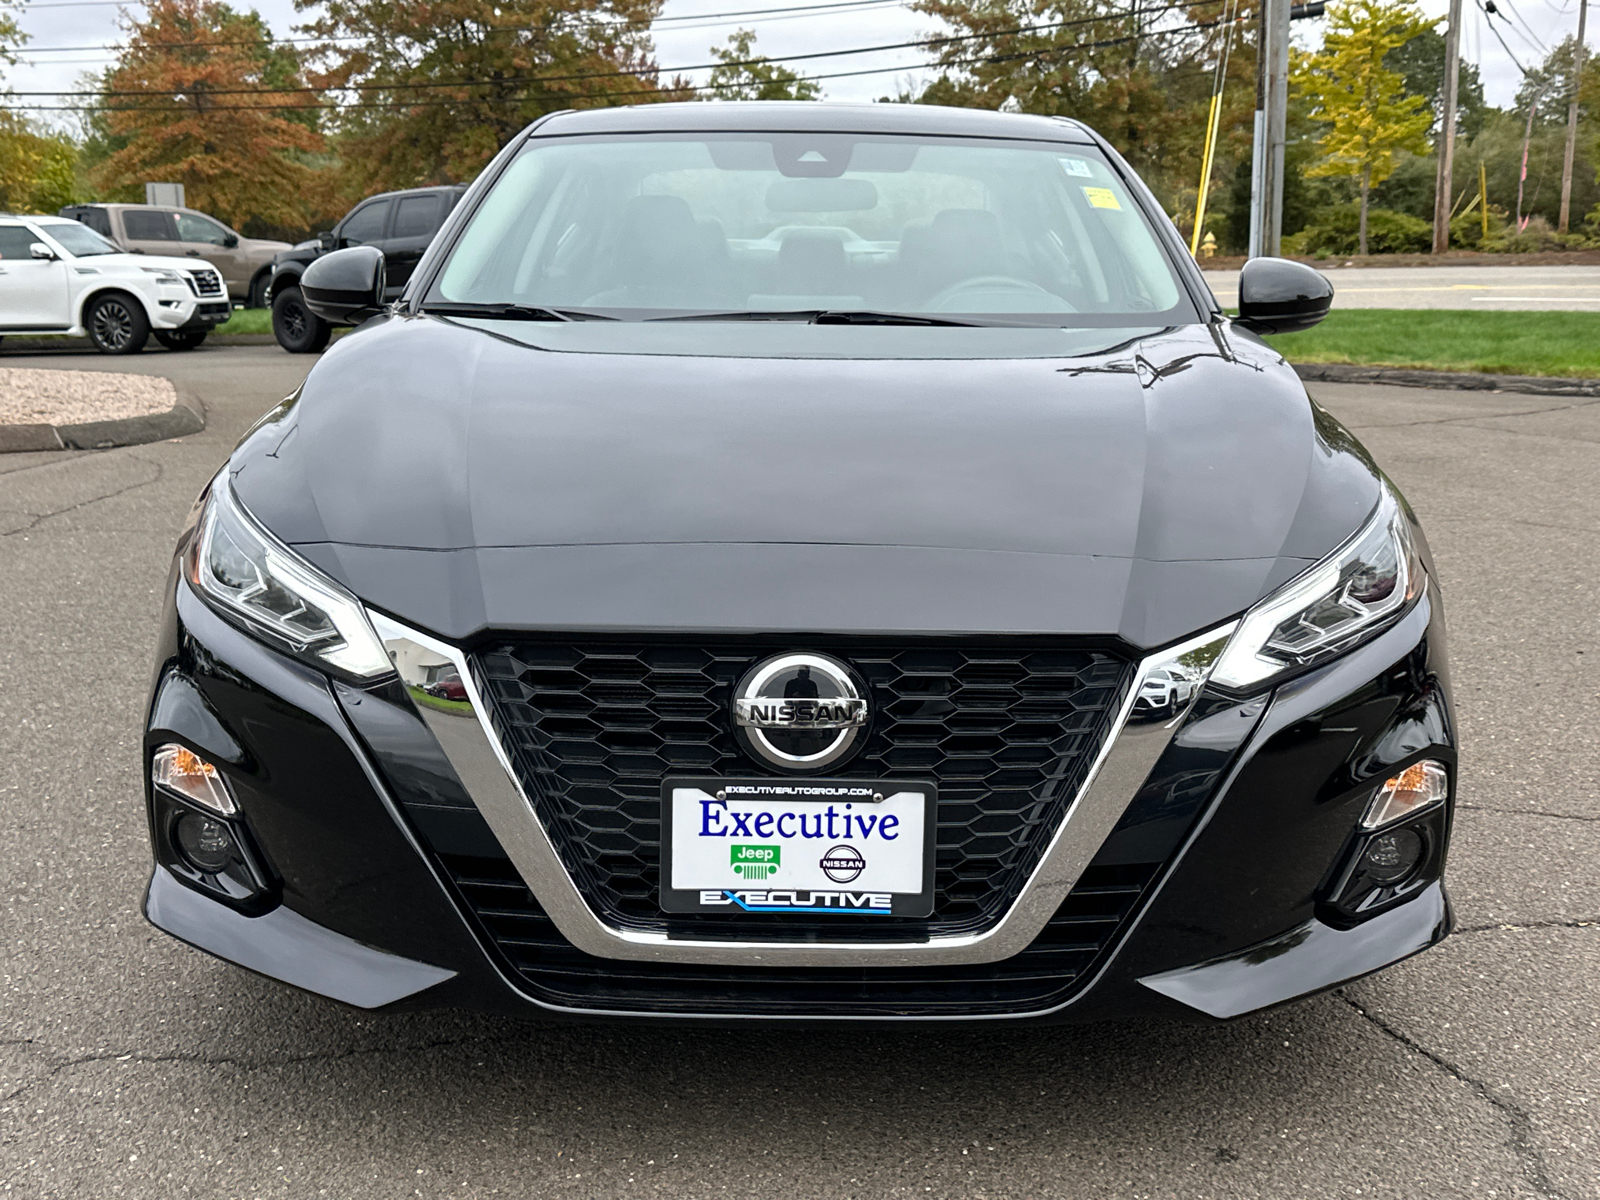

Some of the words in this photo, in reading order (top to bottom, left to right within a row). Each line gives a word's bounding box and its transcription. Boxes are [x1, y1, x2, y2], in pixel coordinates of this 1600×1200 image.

[750, 704, 853, 721] NISSAN
[725, 785, 873, 796] EXECUTIVEAUTOGROUP.COM
[698, 800, 899, 840] Executive
[737, 846, 774, 861] Jeep
[823, 859, 863, 869] NISSAN
[700, 890, 892, 908] EXECUTIVE
